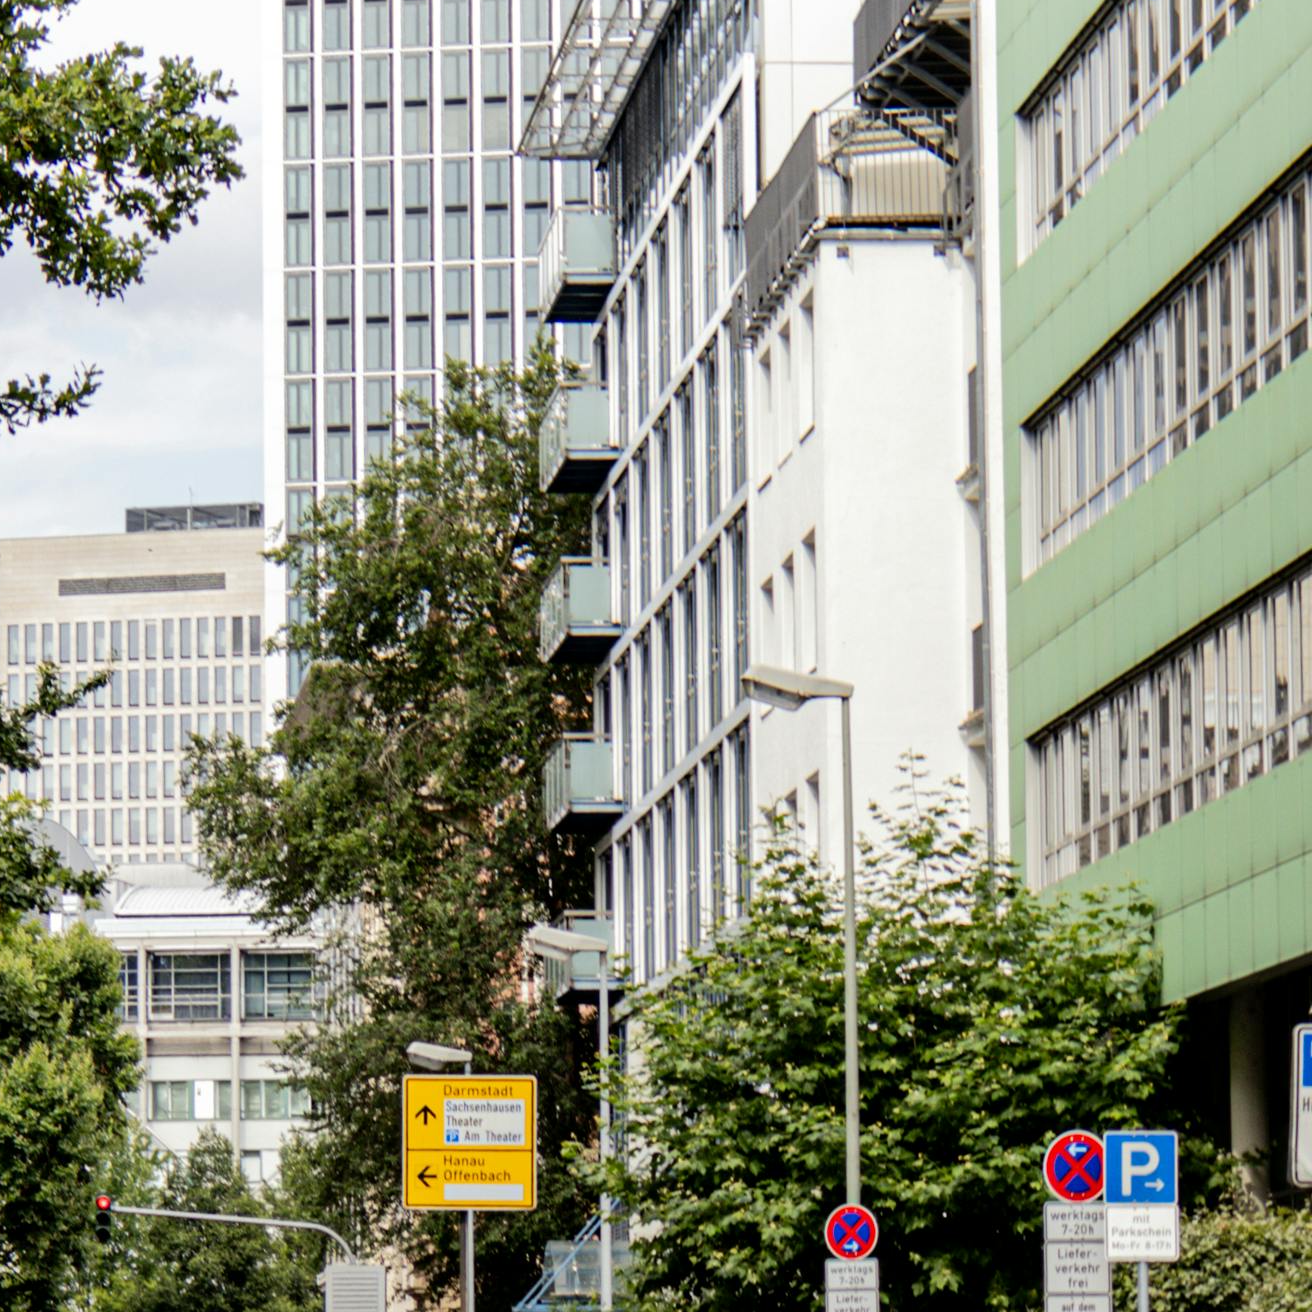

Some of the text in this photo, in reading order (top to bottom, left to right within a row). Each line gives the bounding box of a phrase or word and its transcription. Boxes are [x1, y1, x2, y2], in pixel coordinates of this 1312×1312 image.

[443, 1084, 513, 1097] Darmstadt
[446, 1100, 522, 1113] Sachsenhausen
[446, 1115, 483, 1127] Theater
[464, 1130, 480, 1141] Am
[486, 1130, 522, 1142] Theater
[443, 1155, 485, 1166] Hanau
[1121, 1141, 1160, 1197] P
[443, 1170, 511, 1181] Offenbach
[1050, 1211, 1104, 1222] werktags
[1133, 1215, 1150, 1224] mit
[1061, 1225, 1094, 1235] 7-20h
[1111, 1228, 1172, 1237] Parkschein
[1057, 1249, 1097, 1260] Liefer-
[830, 1266, 873, 1276] werktags
[1055, 1264, 1101, 1273] verkehr
[1068, 1278, 1088, 1288] frei
[1061, 1303, 1096, 1312] auf dem
